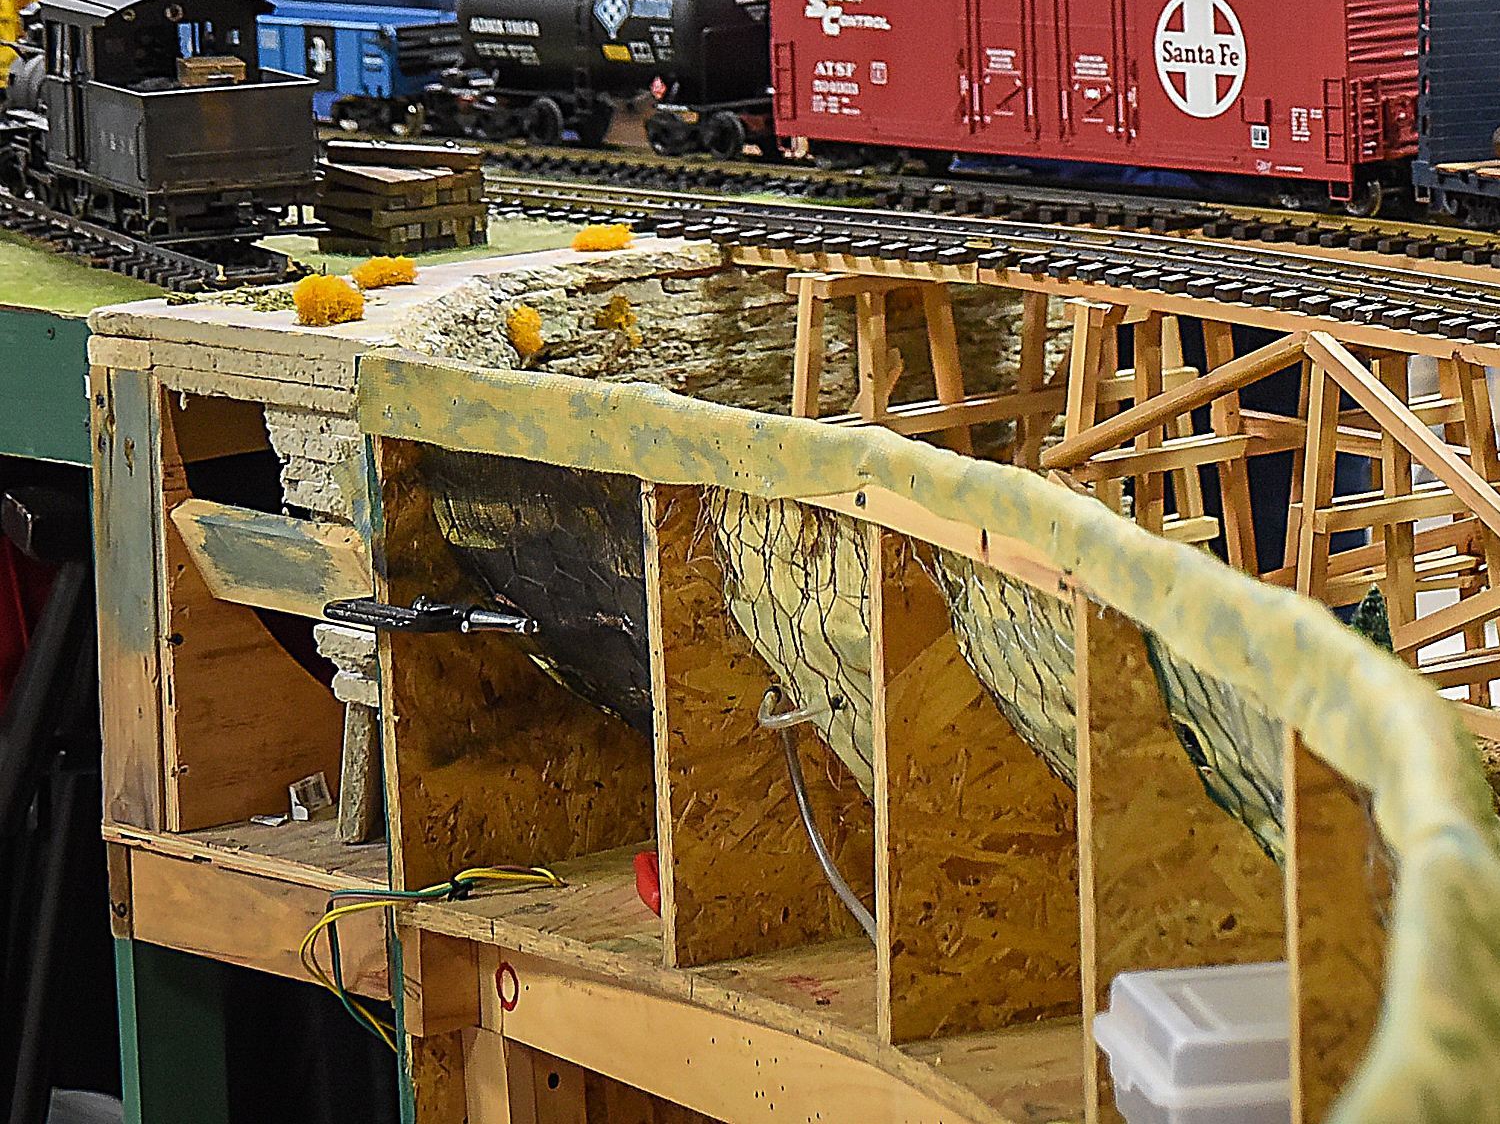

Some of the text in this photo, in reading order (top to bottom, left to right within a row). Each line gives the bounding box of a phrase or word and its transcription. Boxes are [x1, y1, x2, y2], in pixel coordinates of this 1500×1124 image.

[1162, 40, 1240, 66] Santa Fe
[813, 61, 857, 77] ATSF
